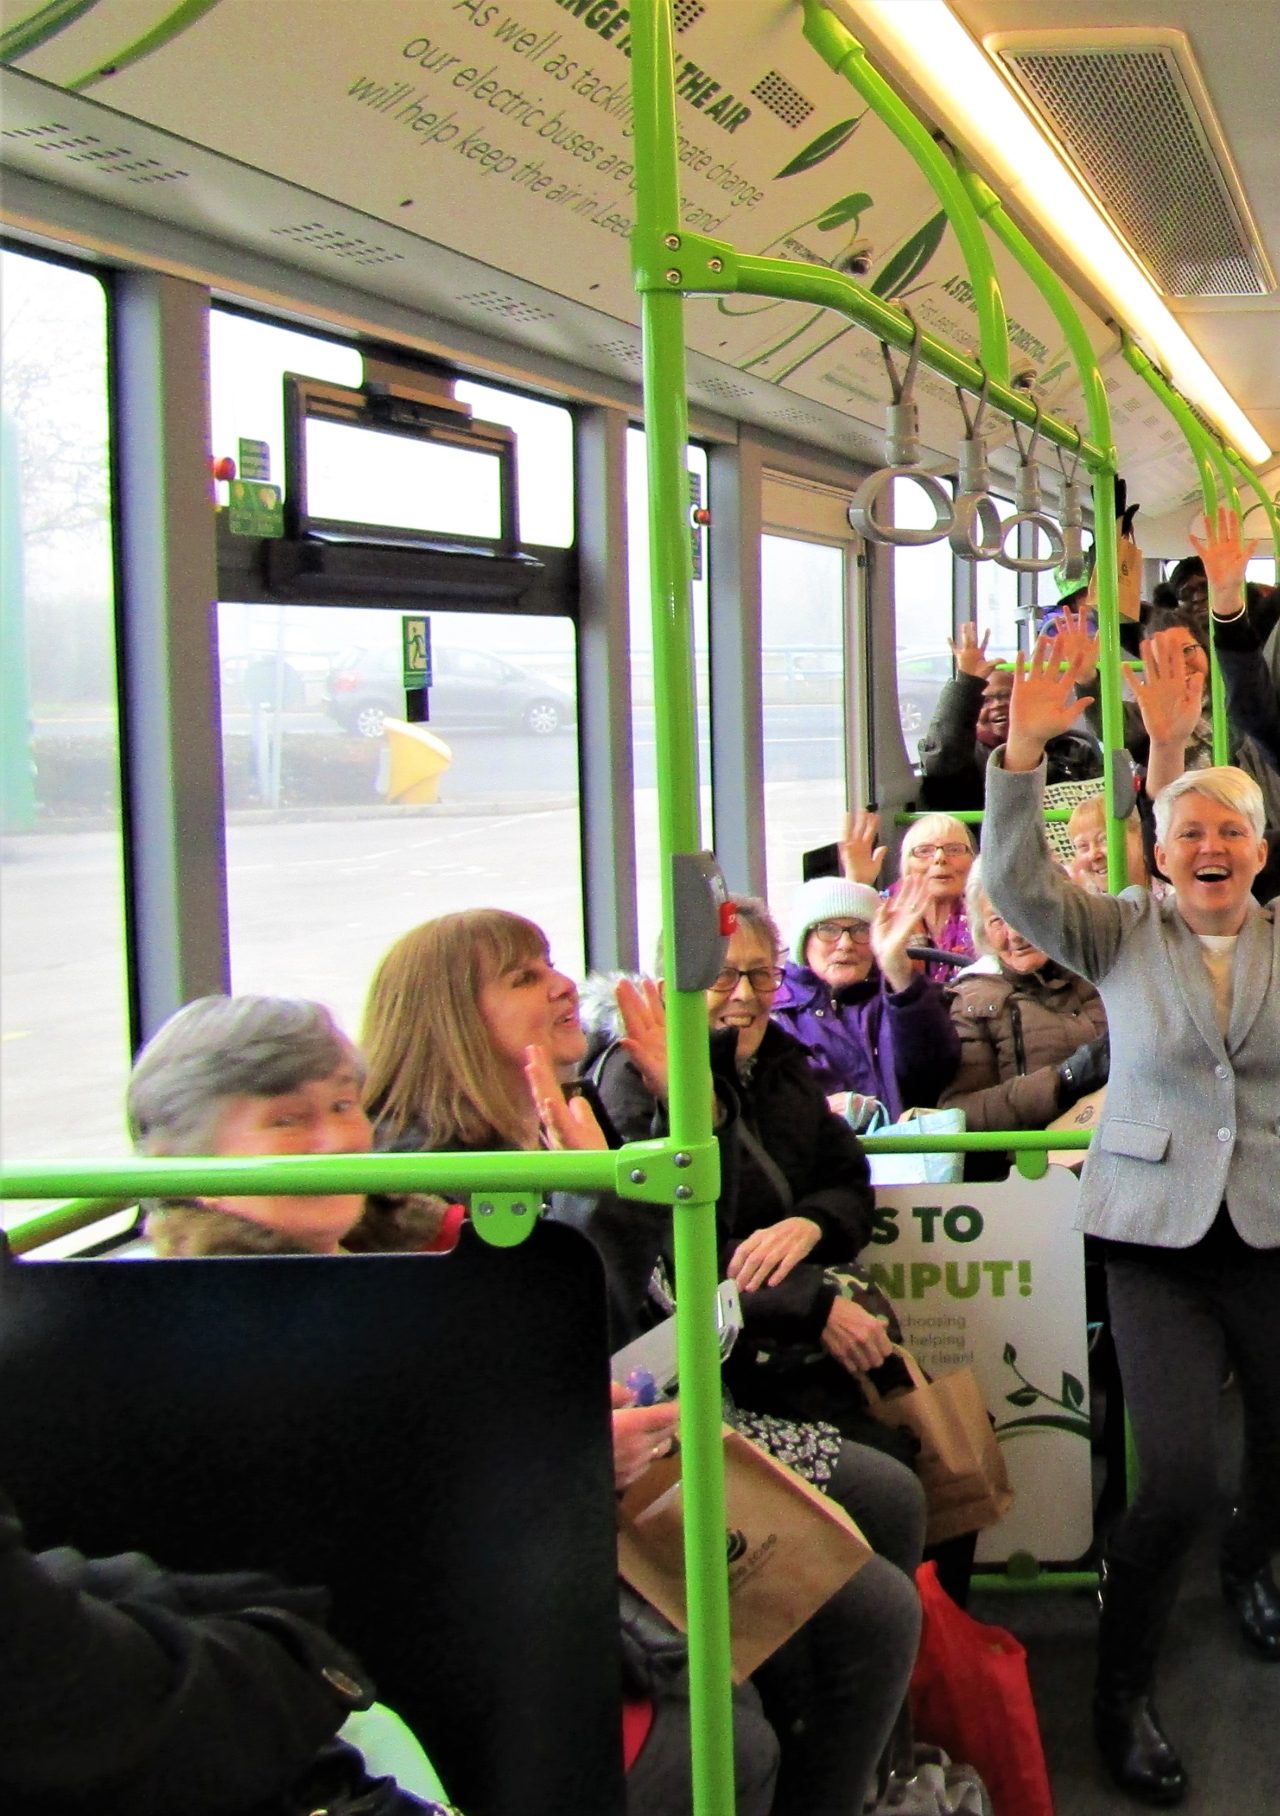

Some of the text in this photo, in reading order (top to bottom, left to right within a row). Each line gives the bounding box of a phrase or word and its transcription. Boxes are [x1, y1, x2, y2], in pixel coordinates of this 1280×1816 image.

[453, 0, 499, 27] As
[493, 17, 563, 62] well
[543, 53, 578, 81] as
[402, 38, 730, 233] our electric buses are and
[703, 94, 752, 134] AIR
[348, 76, 416, 113] will
[393, 94, 460, 146] help
[452, 126, 518, 176] keep
[511, 160, 553, 192] the
[545, 183, 584, 205] air
[570, 192, 599, 217] in
[912, 1205, 984, 1243] TO
[869, 1260, 1033, 1299] NPUT!
